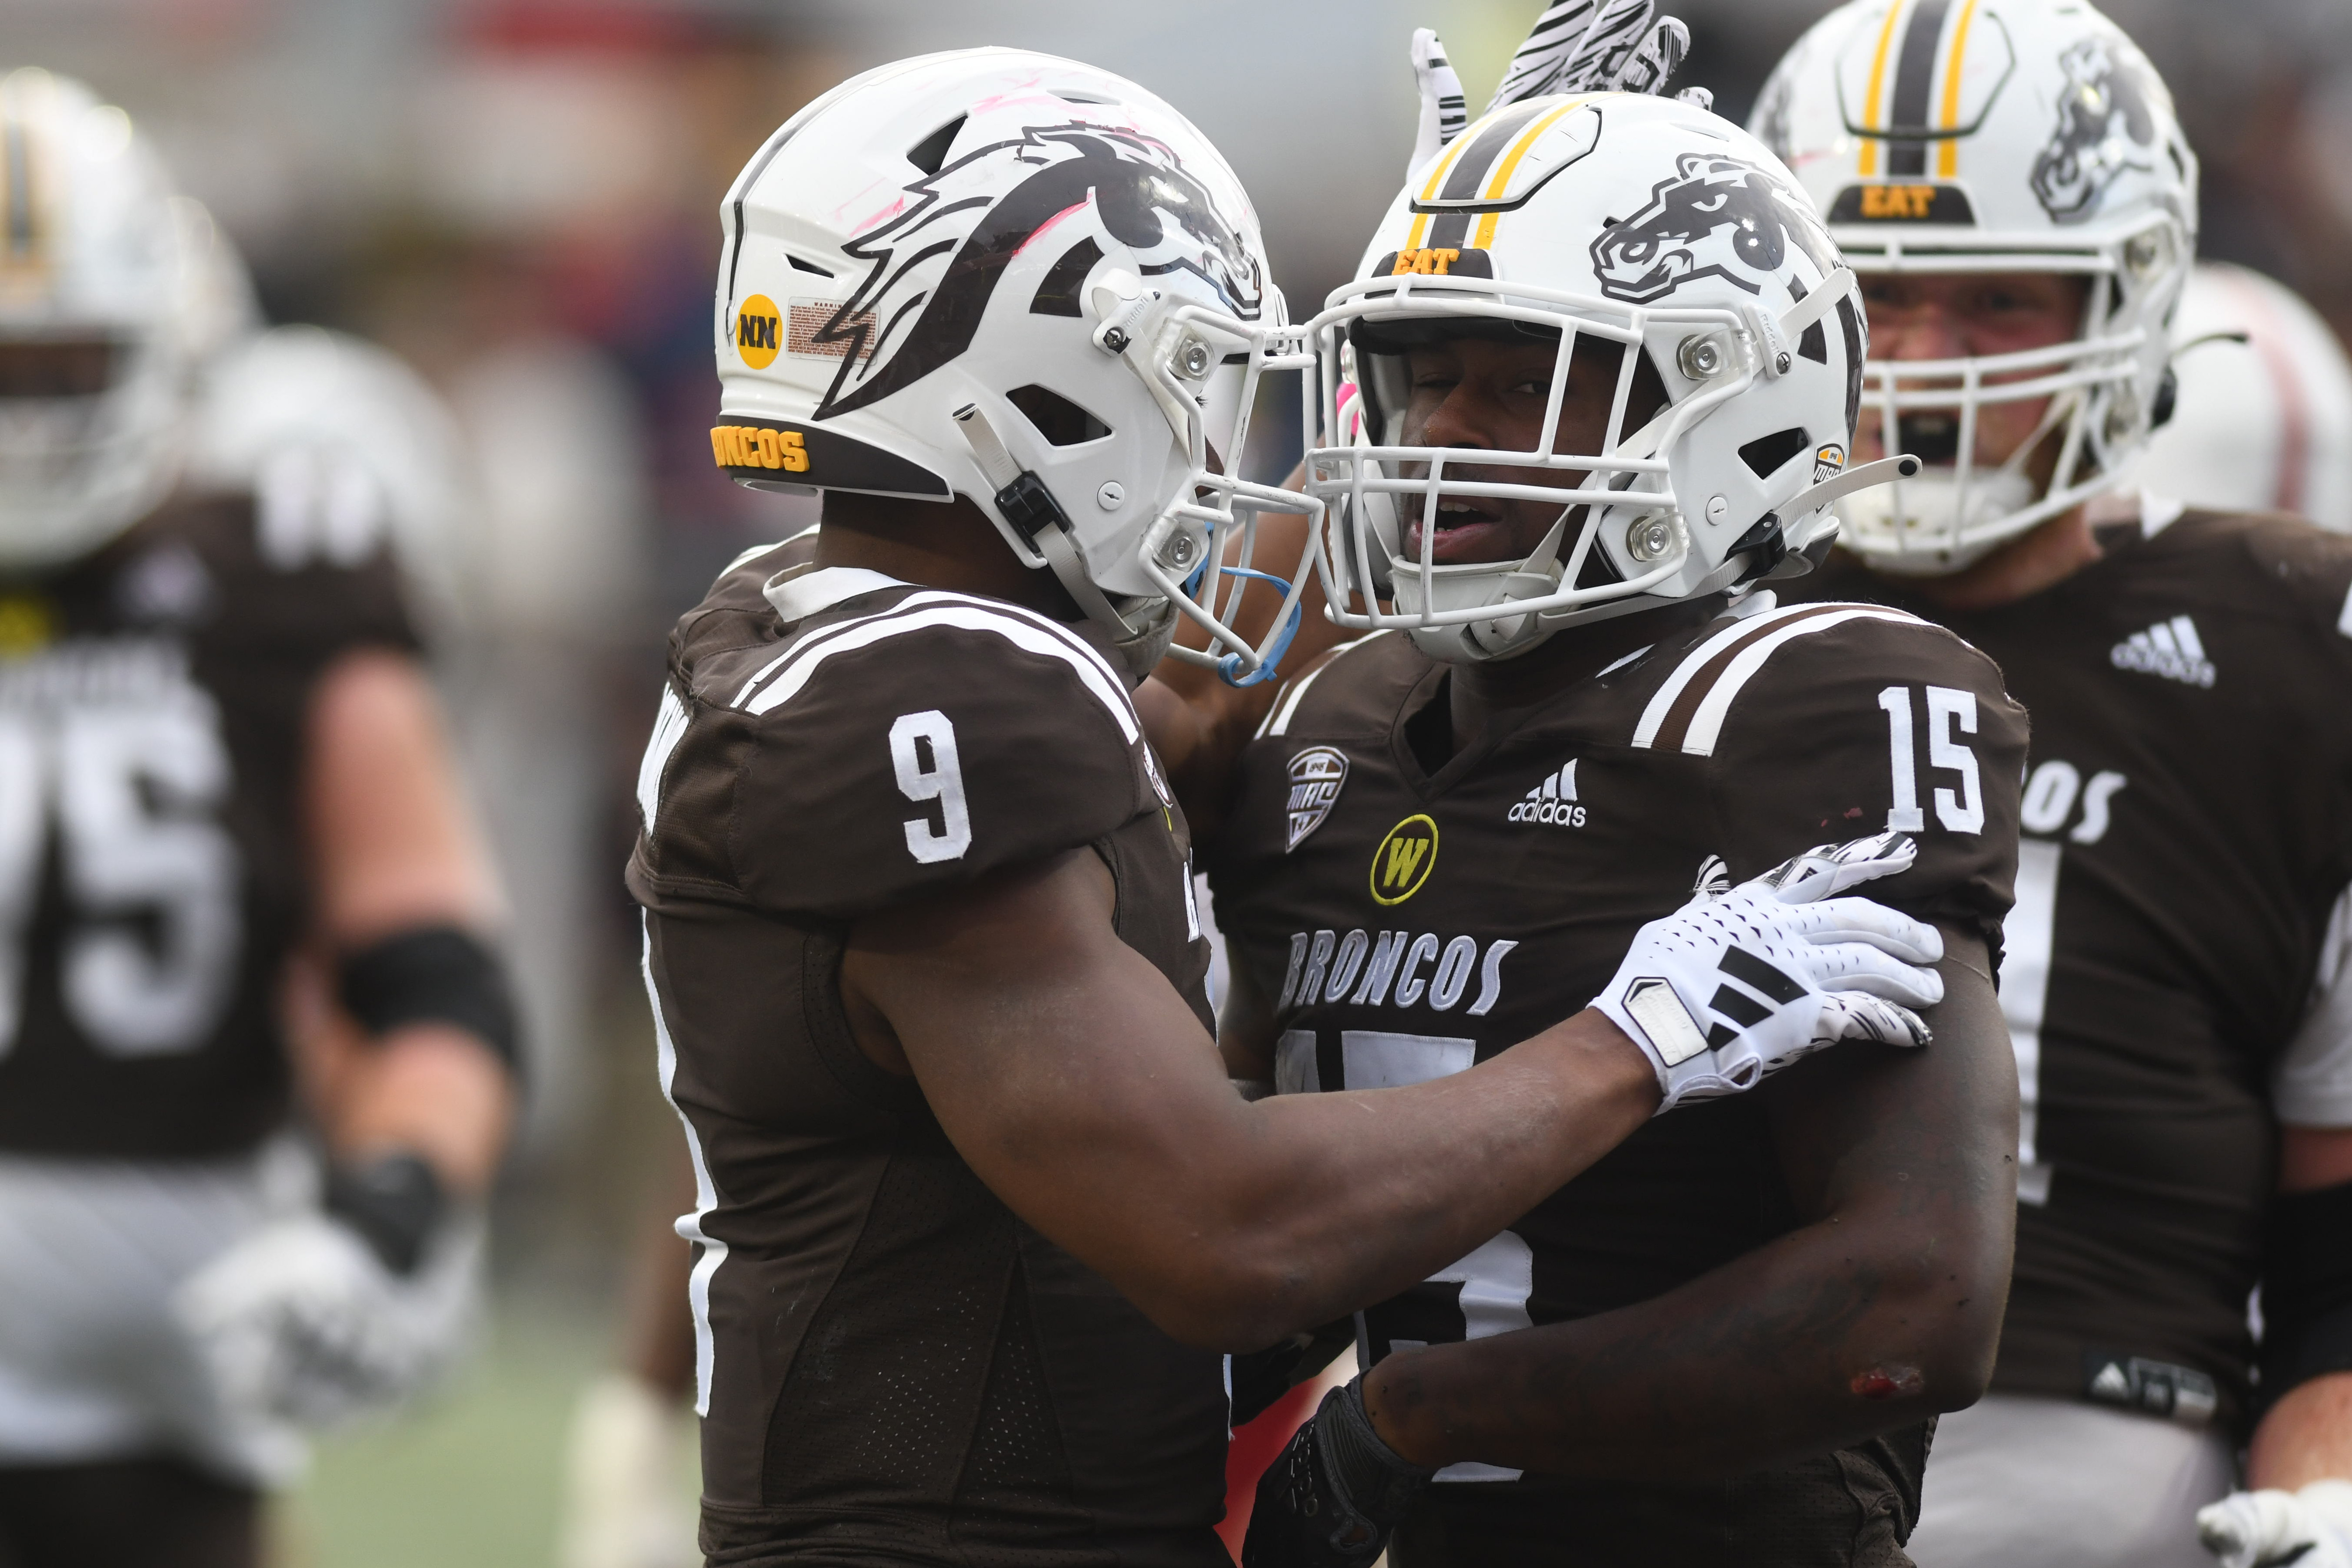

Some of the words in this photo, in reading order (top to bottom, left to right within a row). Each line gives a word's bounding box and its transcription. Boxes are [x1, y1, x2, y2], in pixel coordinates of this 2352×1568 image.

[1861, 185, 1936, 217] EAT
[1392, 248, 1460, 276] EAT
[740, 314, 777, 349] NN
[1878, 685, 1985, 835] 15
[889, 710, 972, 864] 9
[1507, 798, 1586, 828] adidas
[1383, 838, 1429, 888] W
[1276, 928, 1519, 1016] BRONCOS
